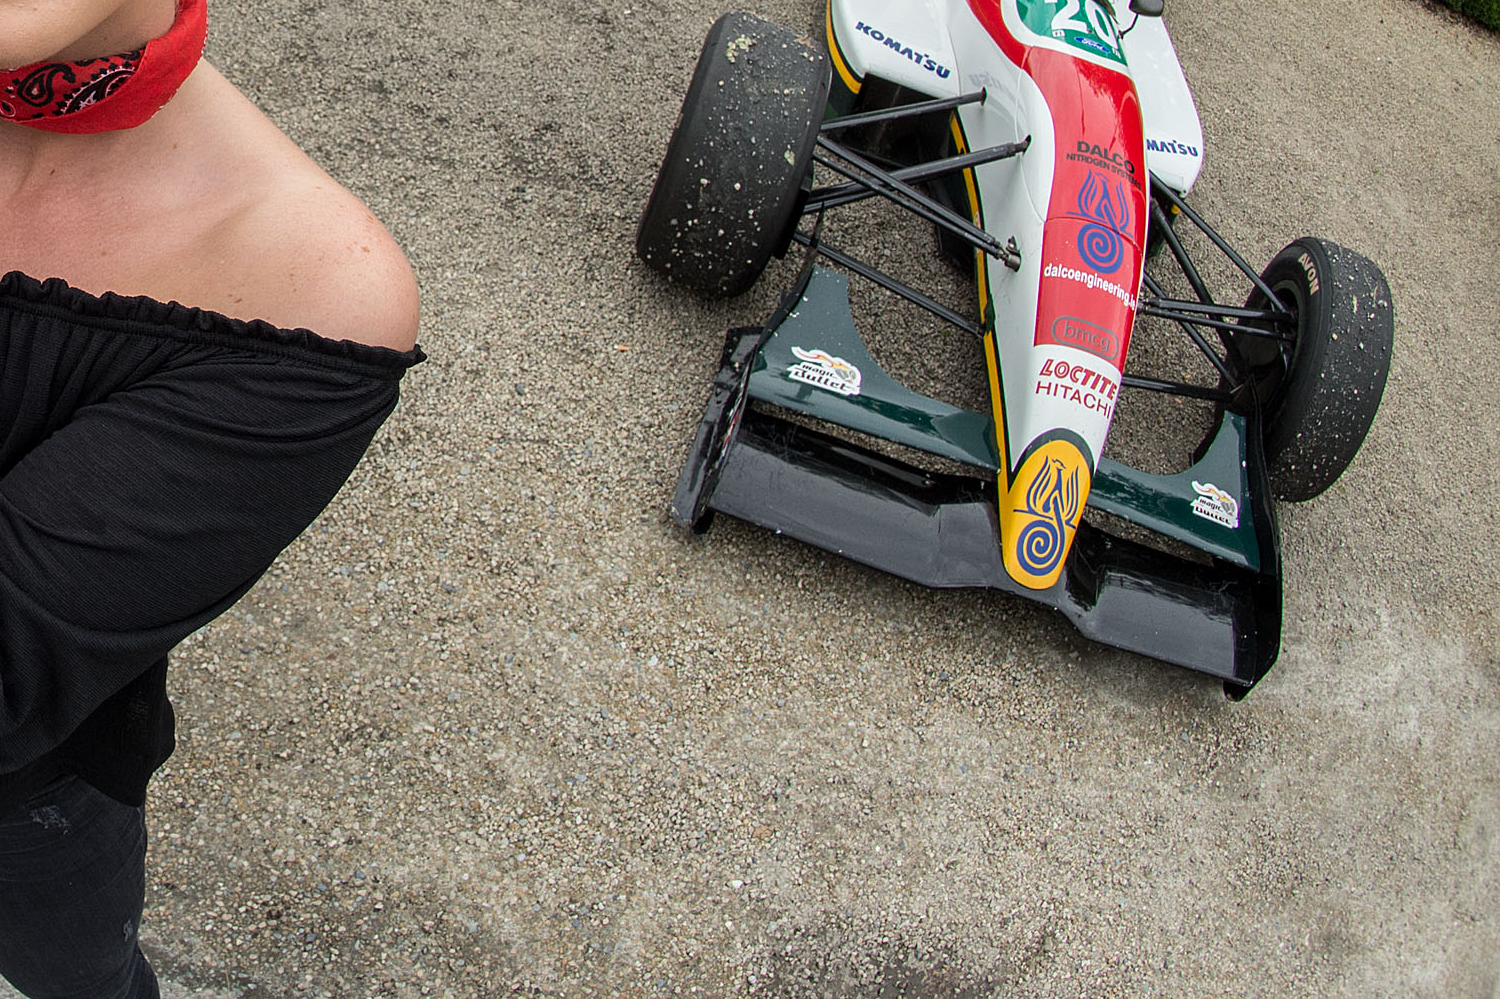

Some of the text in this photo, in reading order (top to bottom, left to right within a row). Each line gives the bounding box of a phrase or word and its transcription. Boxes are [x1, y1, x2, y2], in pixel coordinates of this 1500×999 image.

[855, 21, 951, 79] KOMATSU
[1076, 140, 1136, 175] DALCO
[1146, 139, 1199, 157] MATSU
[1066, 153, 1142, 191] NITROGEN SYSTEMS
[1044, 263, 1136, 311] dalcoengineering.ie
[1298, 252, 1320, 296] AVON
[1064, 321, 1111, 353] bmcg
[802, 364, 834, 377] magic
[1039, 358, 1118, 401] LOCTITE
[1035, 381, 1112, 419] HITACHI
[1199, 499, 1221, 510] magic
